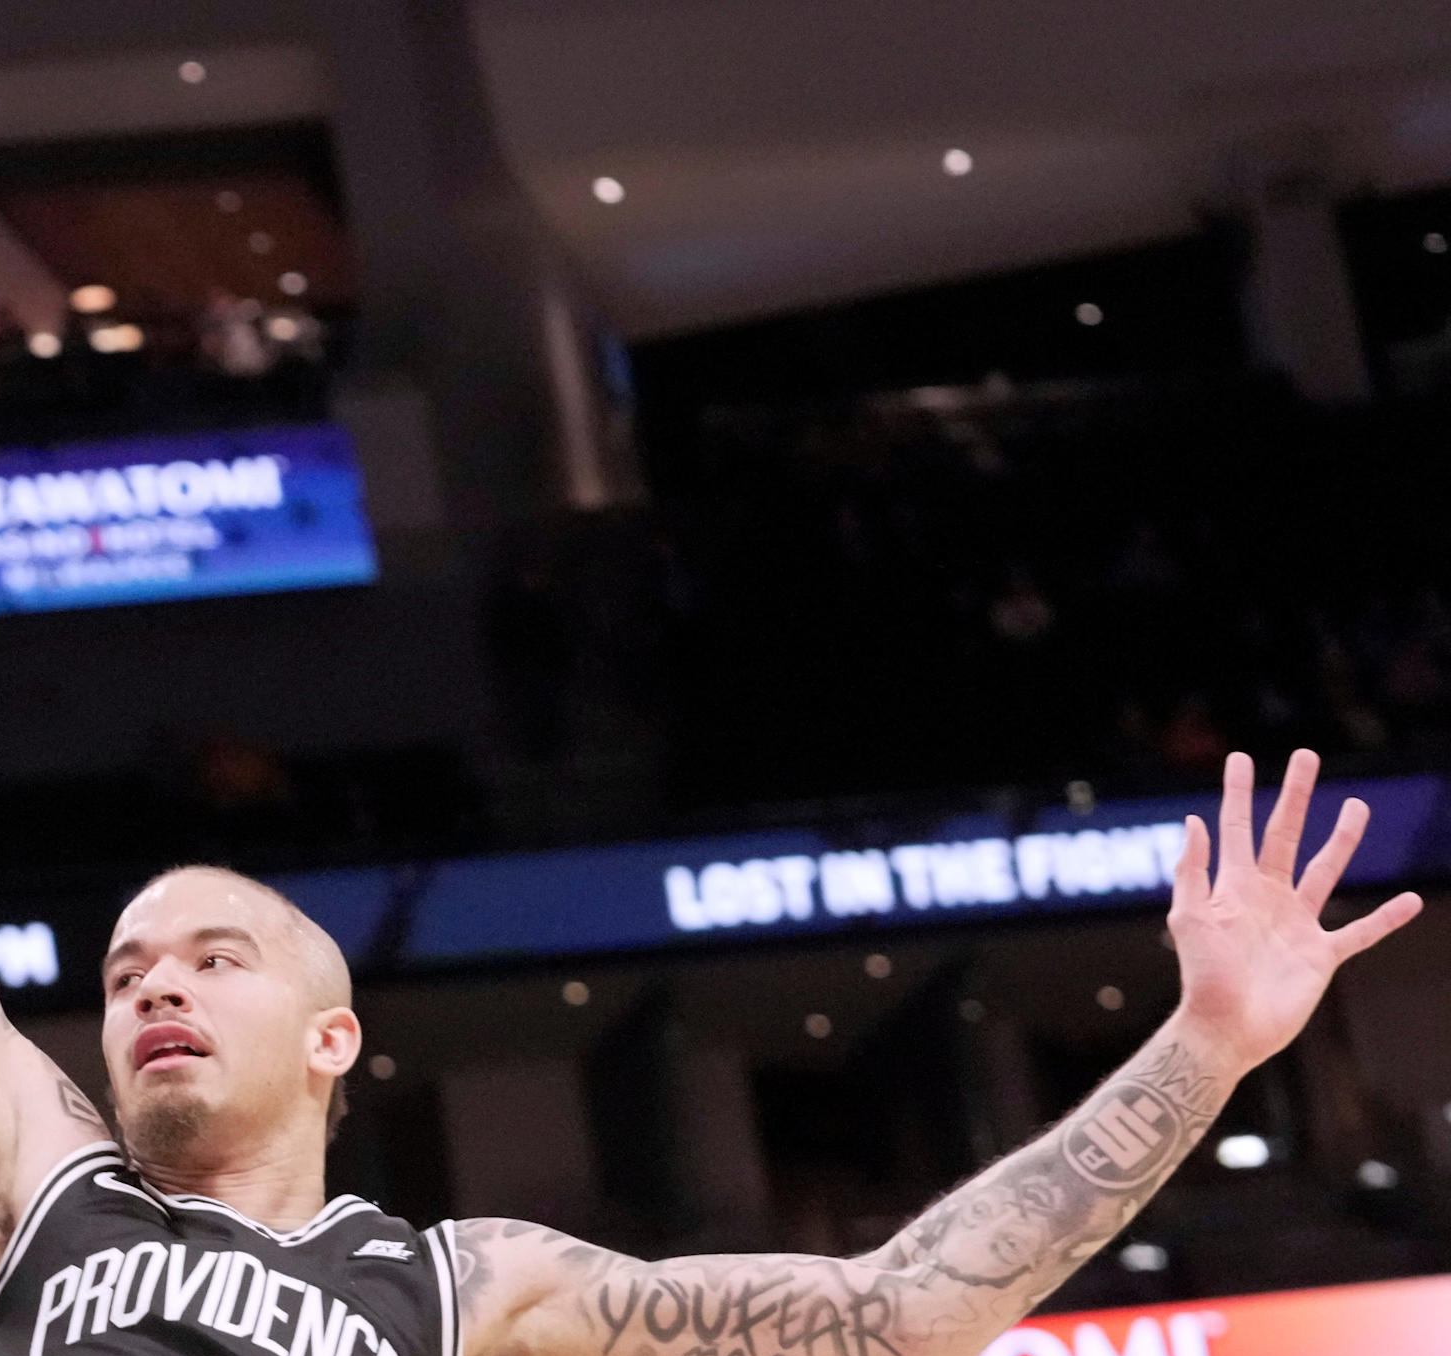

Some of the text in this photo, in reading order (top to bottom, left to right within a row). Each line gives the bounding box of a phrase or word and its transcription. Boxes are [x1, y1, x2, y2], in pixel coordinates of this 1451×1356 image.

[663, 855, 816, 932] LOST
[818, 848, 896, 918] IN
[889, 838, 1019, 911] THE
